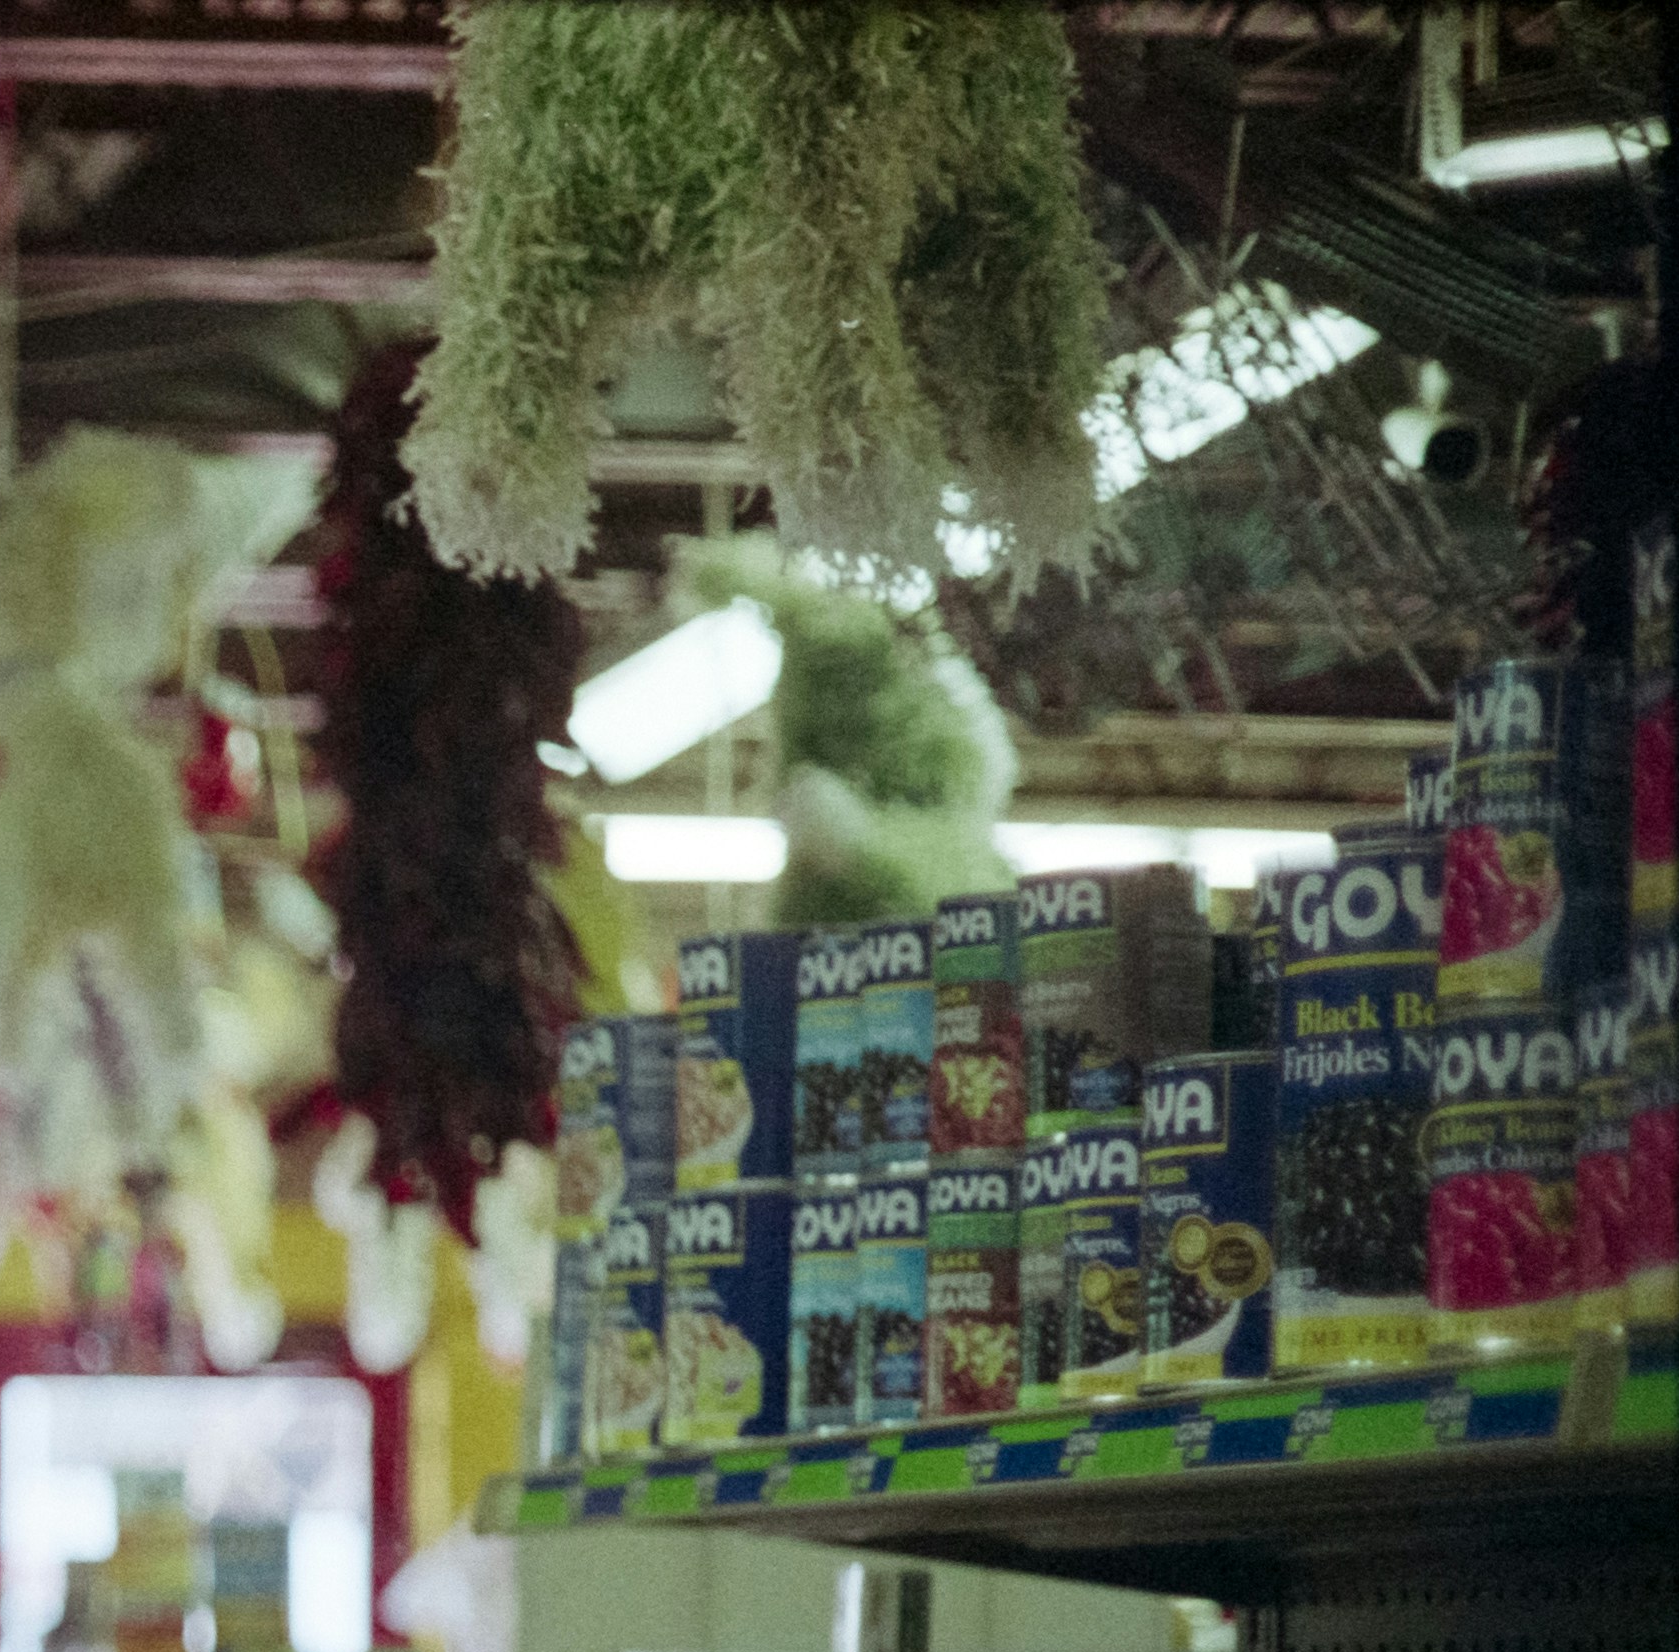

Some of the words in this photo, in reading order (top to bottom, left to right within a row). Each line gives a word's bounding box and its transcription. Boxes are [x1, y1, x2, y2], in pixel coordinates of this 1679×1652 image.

[1455, 683, 1542, 747] YA
[1291, 864, 1441, 952] GOY
[862, 929, 925, 985] YA
[1295, 993, 1382, 1038] Black
[1282, 1037, 1392, 1089] Frijoles
[1434, 1029, 1578, 1096] OYA
[1142, 1077, 1216, 1135] YA
[1067, 1137, 1139, 1189] YA
[856, 1186, 922, 1239] YA
